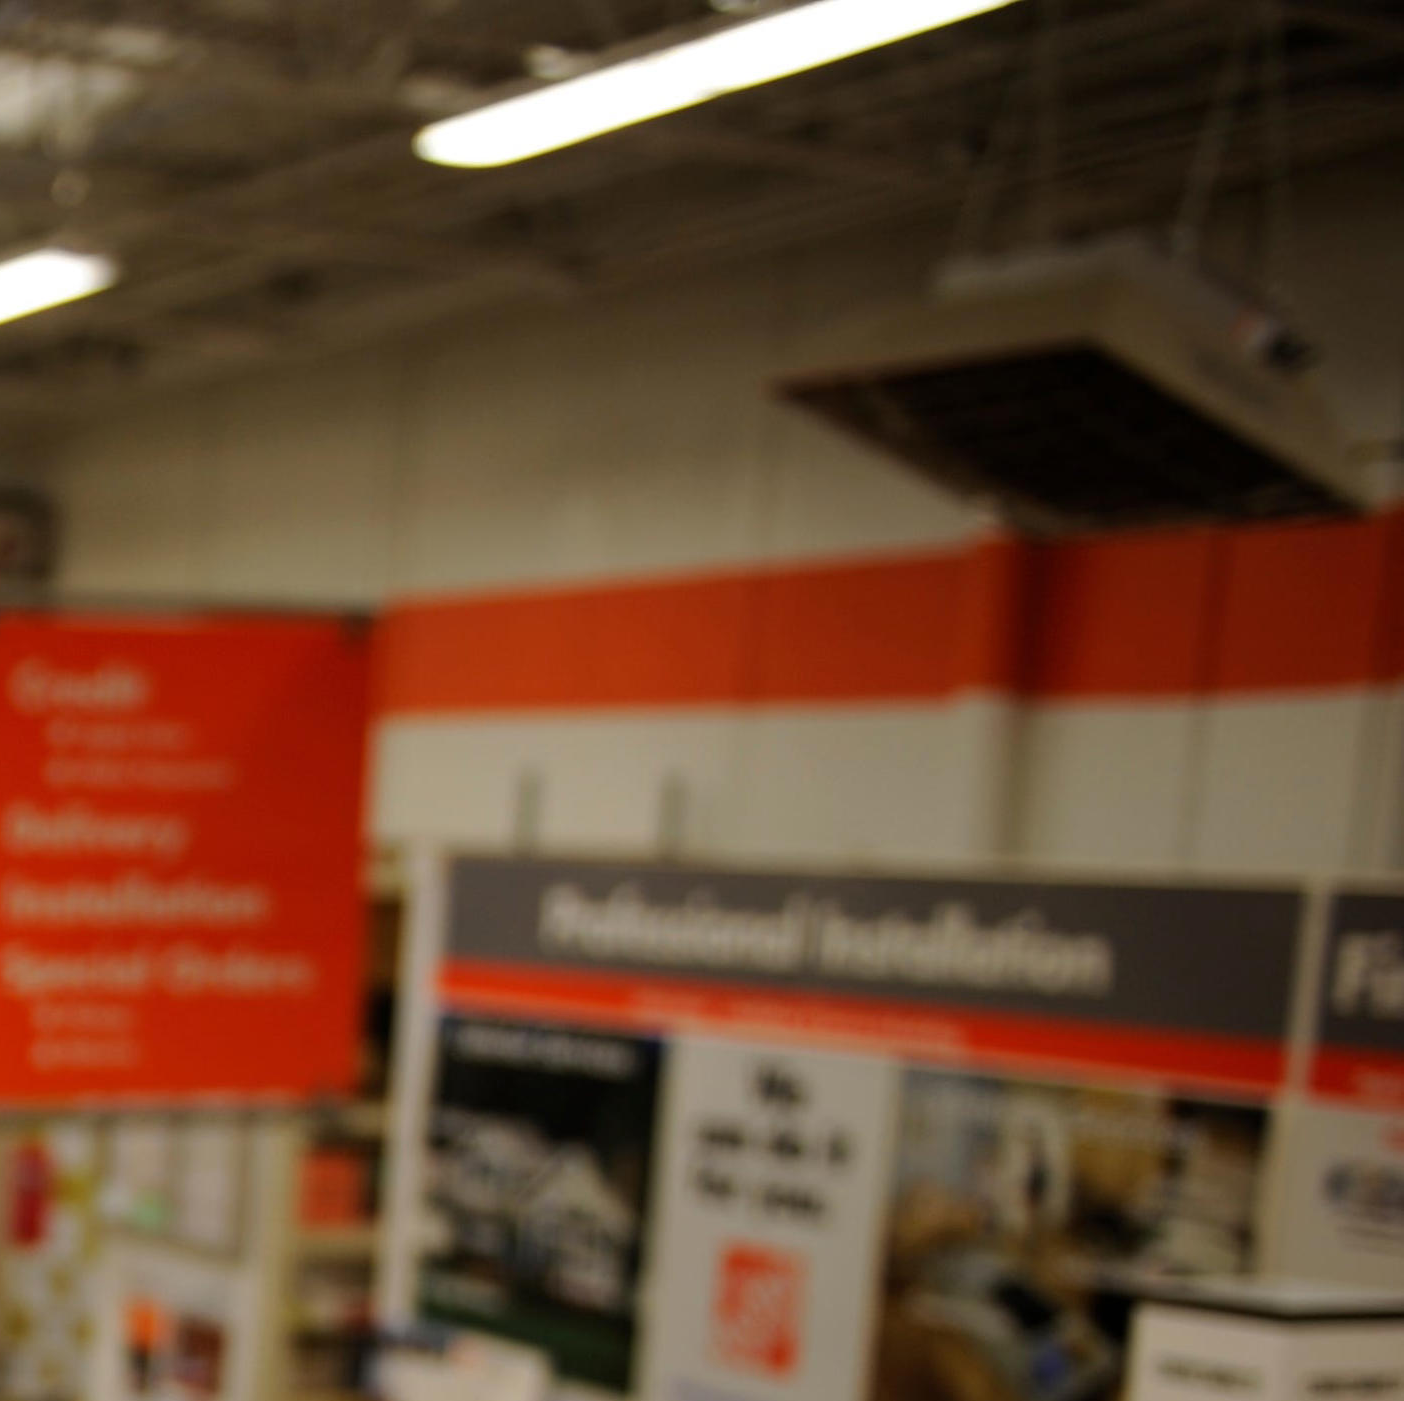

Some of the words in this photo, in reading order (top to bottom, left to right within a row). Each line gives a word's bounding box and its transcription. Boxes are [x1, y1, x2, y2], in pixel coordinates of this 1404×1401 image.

[1, 872, 271, 926] Installation
[543, 884, 803, 970] Professional
[815, 900, 1109, 993] Installation
